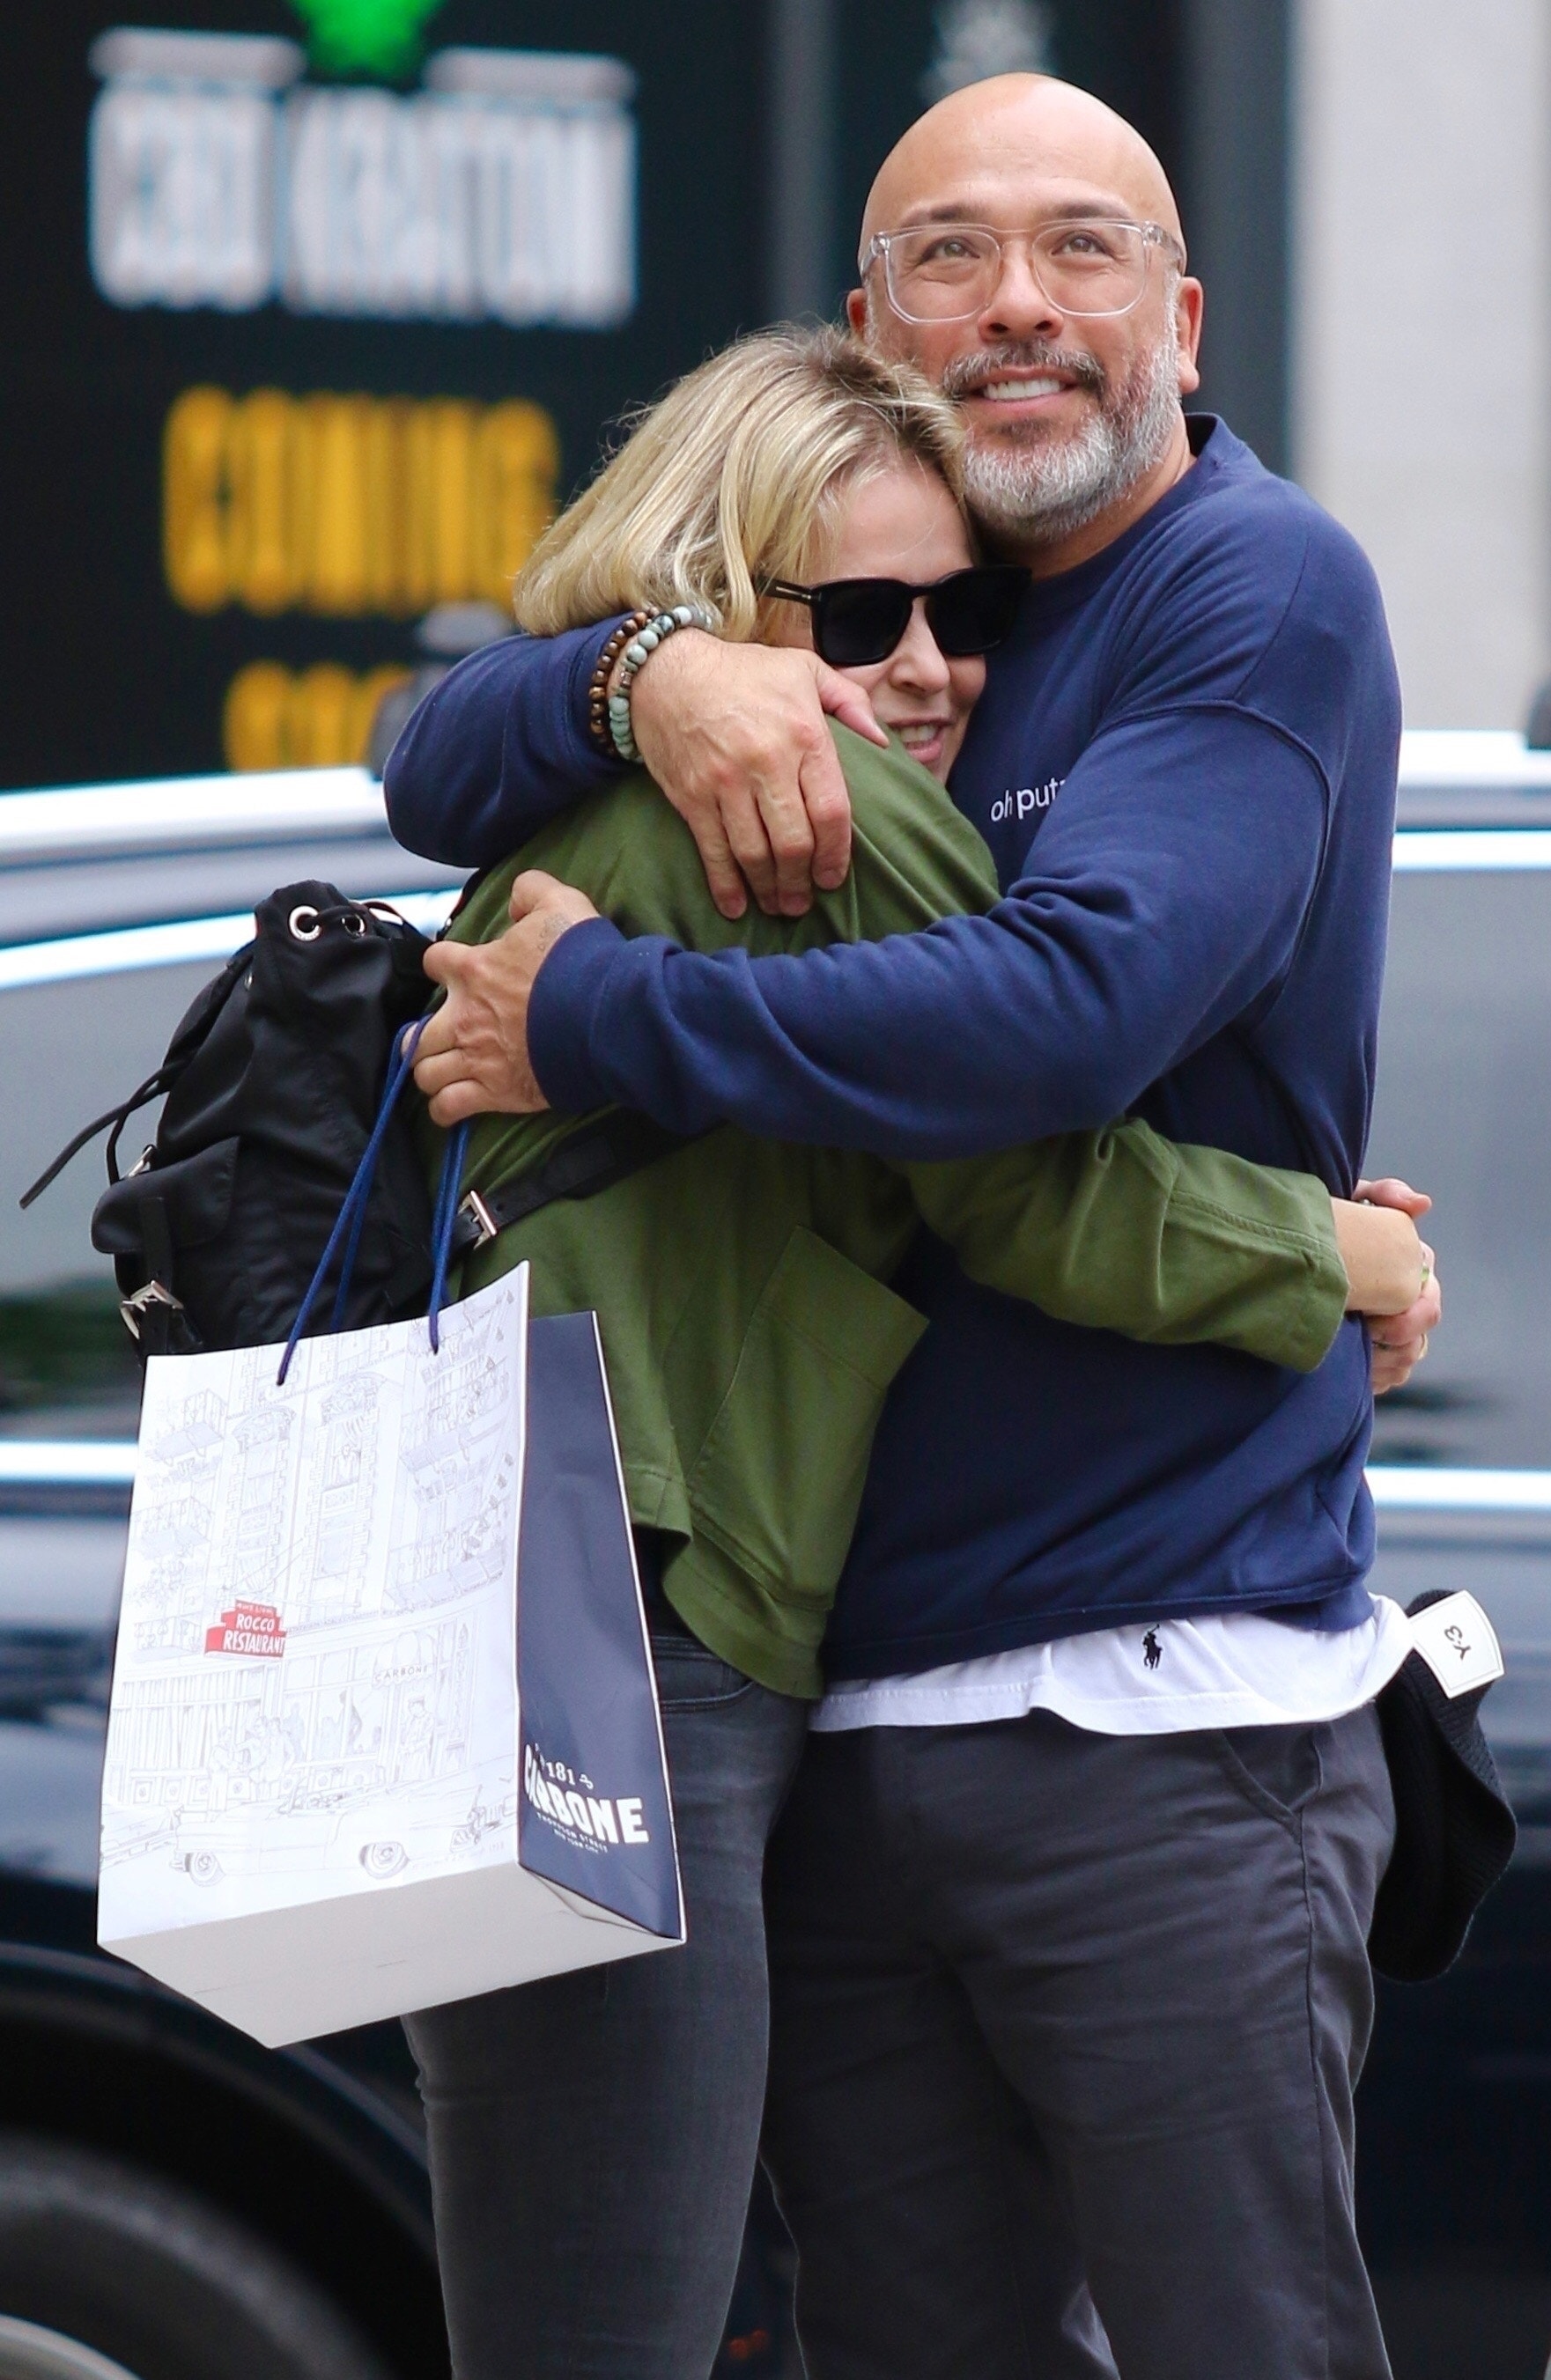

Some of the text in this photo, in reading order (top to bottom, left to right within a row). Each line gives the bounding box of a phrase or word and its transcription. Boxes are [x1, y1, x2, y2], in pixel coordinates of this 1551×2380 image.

[990, 777, 1066, 822] oh put
[235, 1613, 275, 1632] ROCCO
[223, 1630, 286, 1654] RESTAURANT
[545, 1762, 576, 1786] 181
